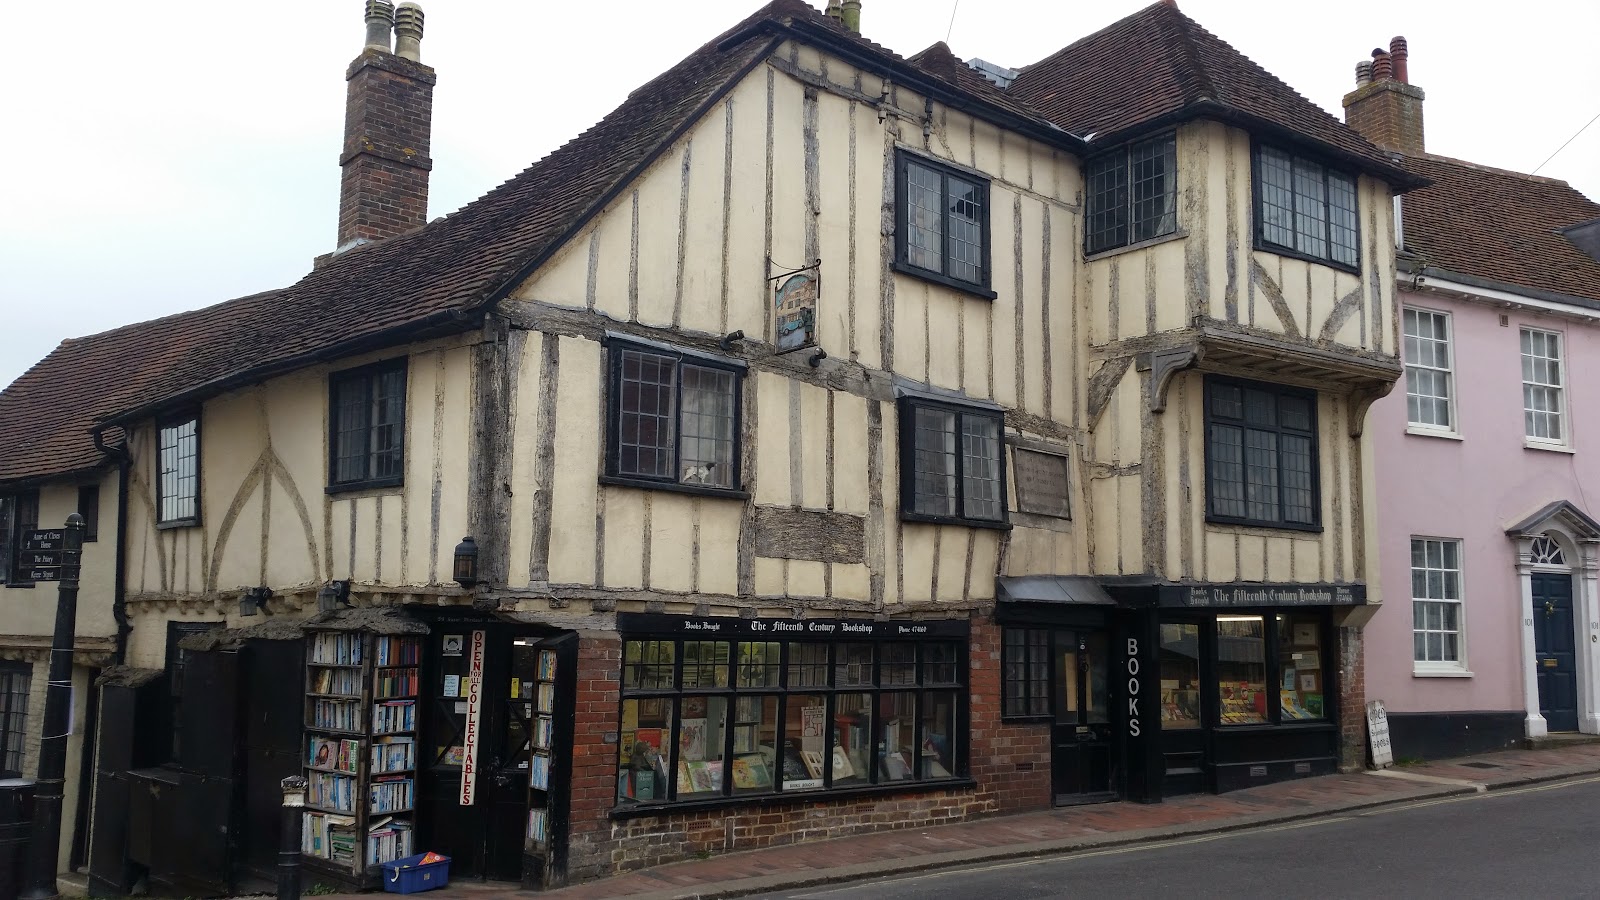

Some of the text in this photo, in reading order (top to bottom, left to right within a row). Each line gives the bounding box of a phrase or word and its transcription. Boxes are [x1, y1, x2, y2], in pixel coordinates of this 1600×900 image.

[1190, 587, 1208, 596] Books
[1214, 588, 1332, 604] The Fifteenth Century Bookshop
[1190, 596, 1209, 606] Bought
[684, 621, 701, 630] Books
[702, 622, 720, 632] Bought
[751, 620, 767, 631] The
[772, 621, 804, 632] Fifteenth
[808, 622, 836, 634] Century
[842, 622, 872, 634] Bookshop
[473, 632, 482, 671] OPEN
[1128, 638, 1140, 736] BOOKS
[463, 684, 478, 805] COLLECTABLES
